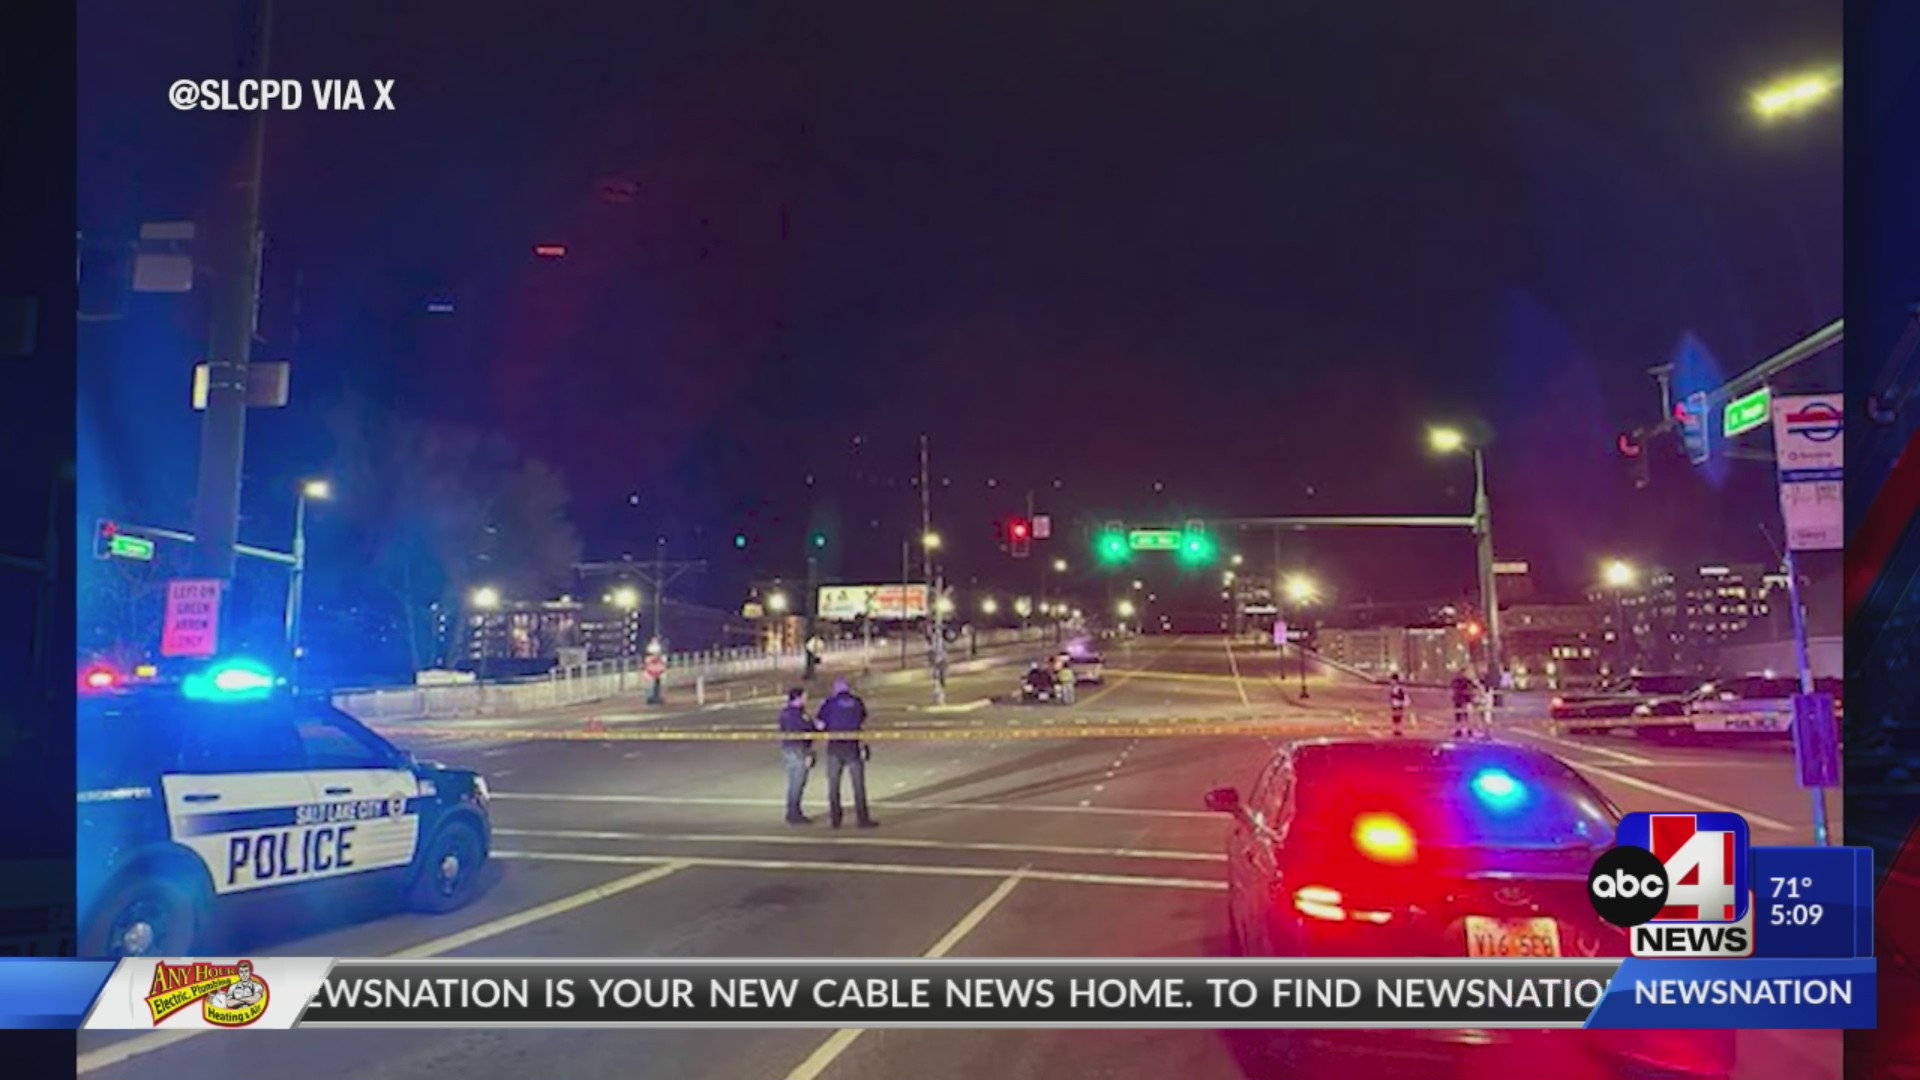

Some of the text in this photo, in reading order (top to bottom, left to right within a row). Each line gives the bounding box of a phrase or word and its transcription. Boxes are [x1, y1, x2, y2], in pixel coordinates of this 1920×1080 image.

[173, 585, 216, 600] LEFT ON
[296, 800, 382, 825] SALT LAKE CITY
[228, 825, 356, 885] POLICE
